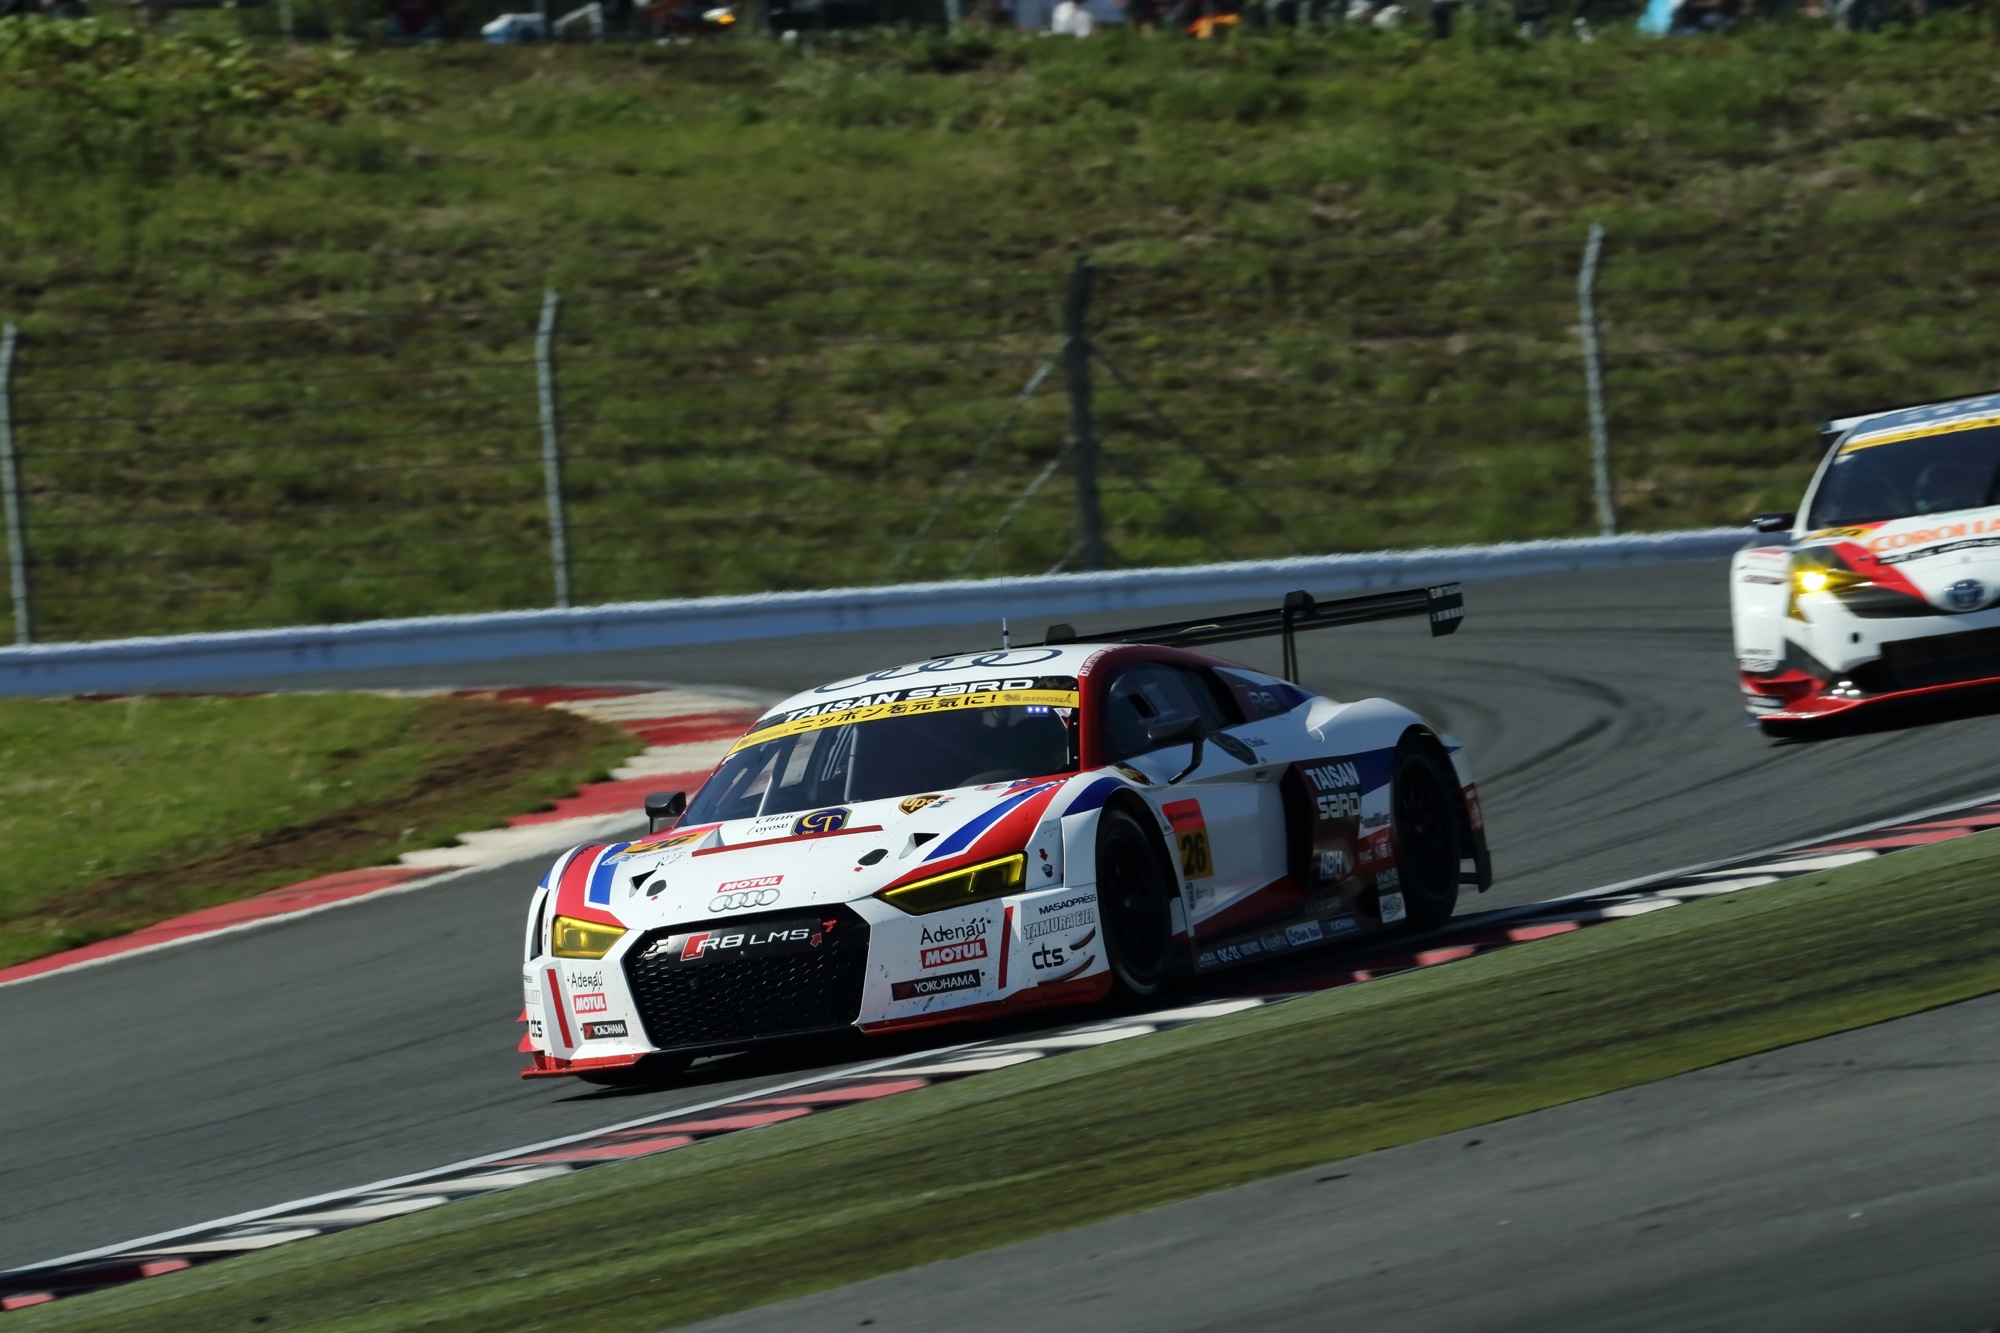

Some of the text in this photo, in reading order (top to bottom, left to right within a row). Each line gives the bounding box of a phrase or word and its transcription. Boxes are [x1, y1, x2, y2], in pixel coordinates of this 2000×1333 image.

[784, 692, 901, 723] TAISAN
[1304, 762, 1361, 790] TAISAN
[1181, 832, 1207, 877] 26
[720, 876, 779, 891] MOTUL
[696, 929, 810, 953] R8 LMS
[924, 941, 984, 966] MOTUL
[1032, 942, 1065, 970] cts
[914, 973, 976, 994] YOKOHAMA
[576, 995, 606, 1012] MOTUL
[592, 1023, 626, 1035] YOKOHAMA
